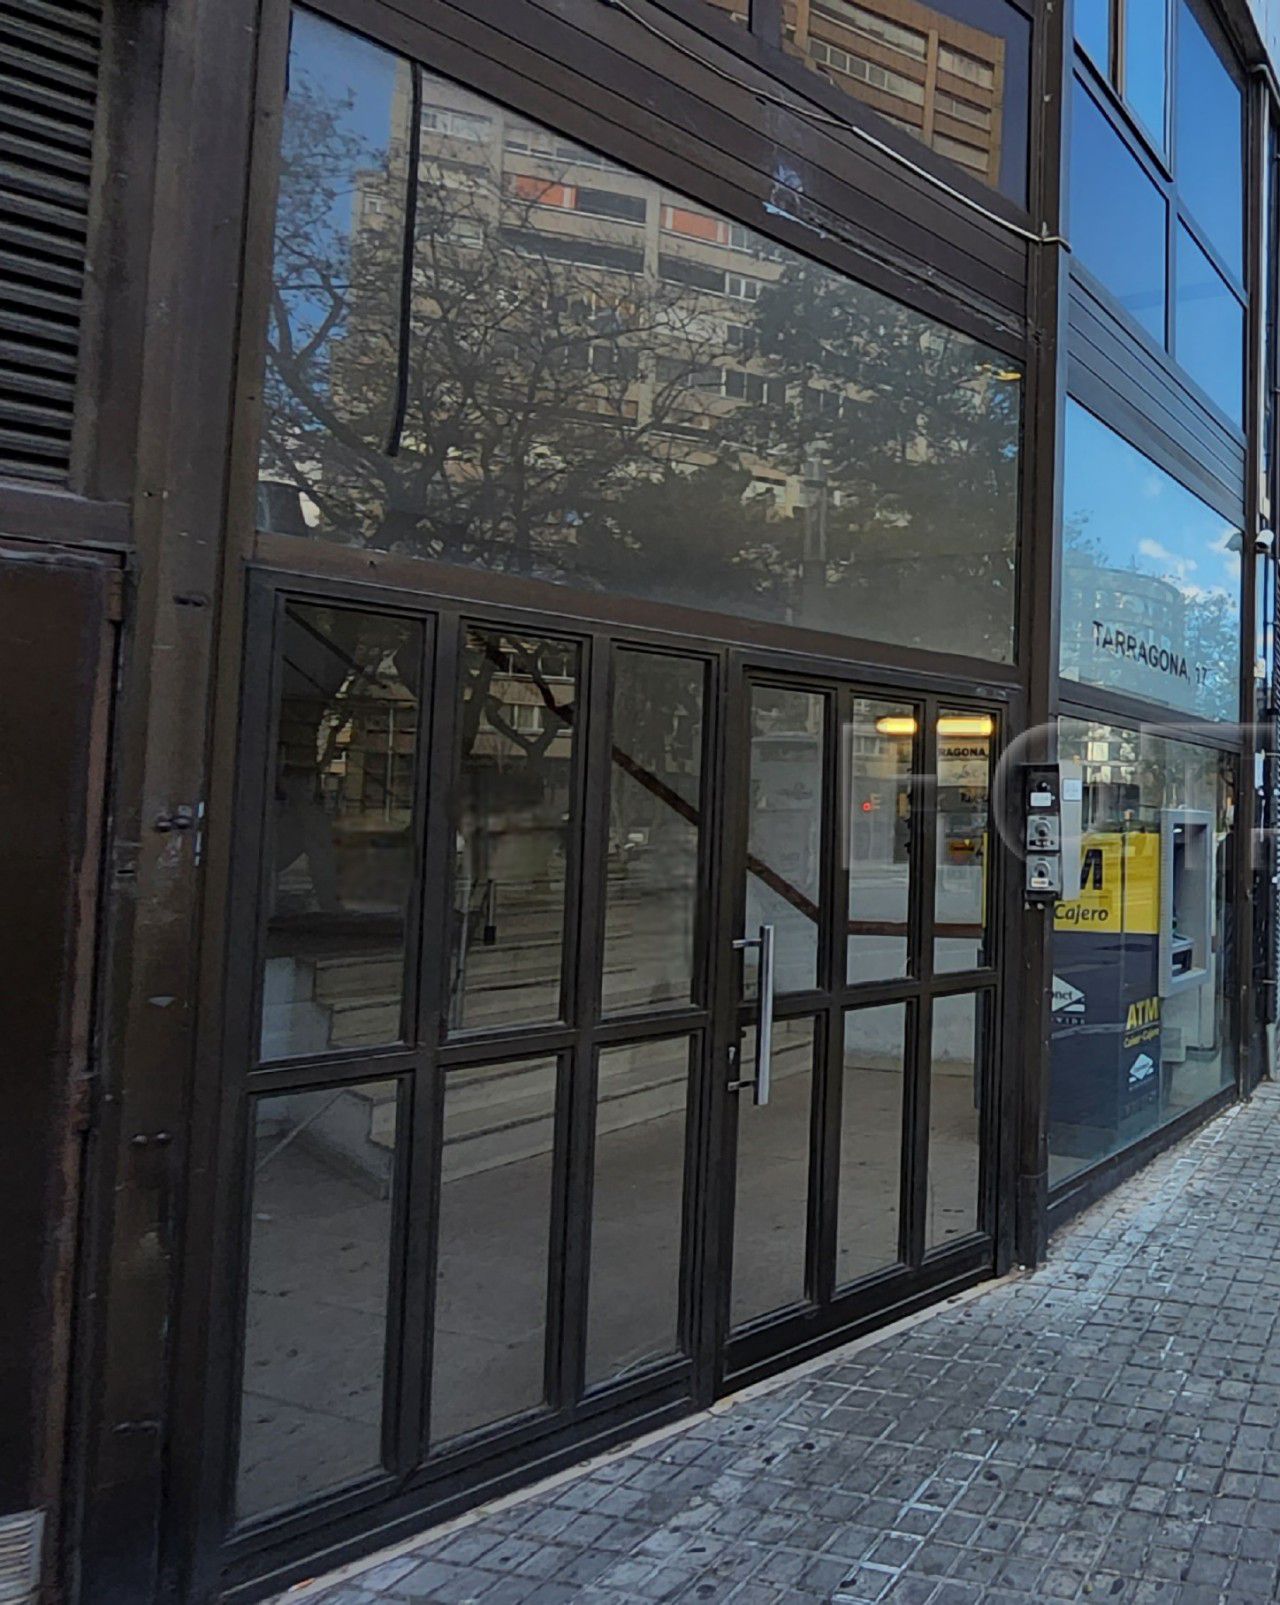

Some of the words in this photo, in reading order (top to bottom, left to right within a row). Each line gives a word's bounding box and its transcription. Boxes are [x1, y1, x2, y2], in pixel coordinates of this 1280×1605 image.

[1092, 620, 1191, 685] TARRAGONA,
[937, 746, 989, 759] RAGONA,
[1053, 903, 1109, 925] Cajero
[1125, 996, 1159, 1031] ATM
